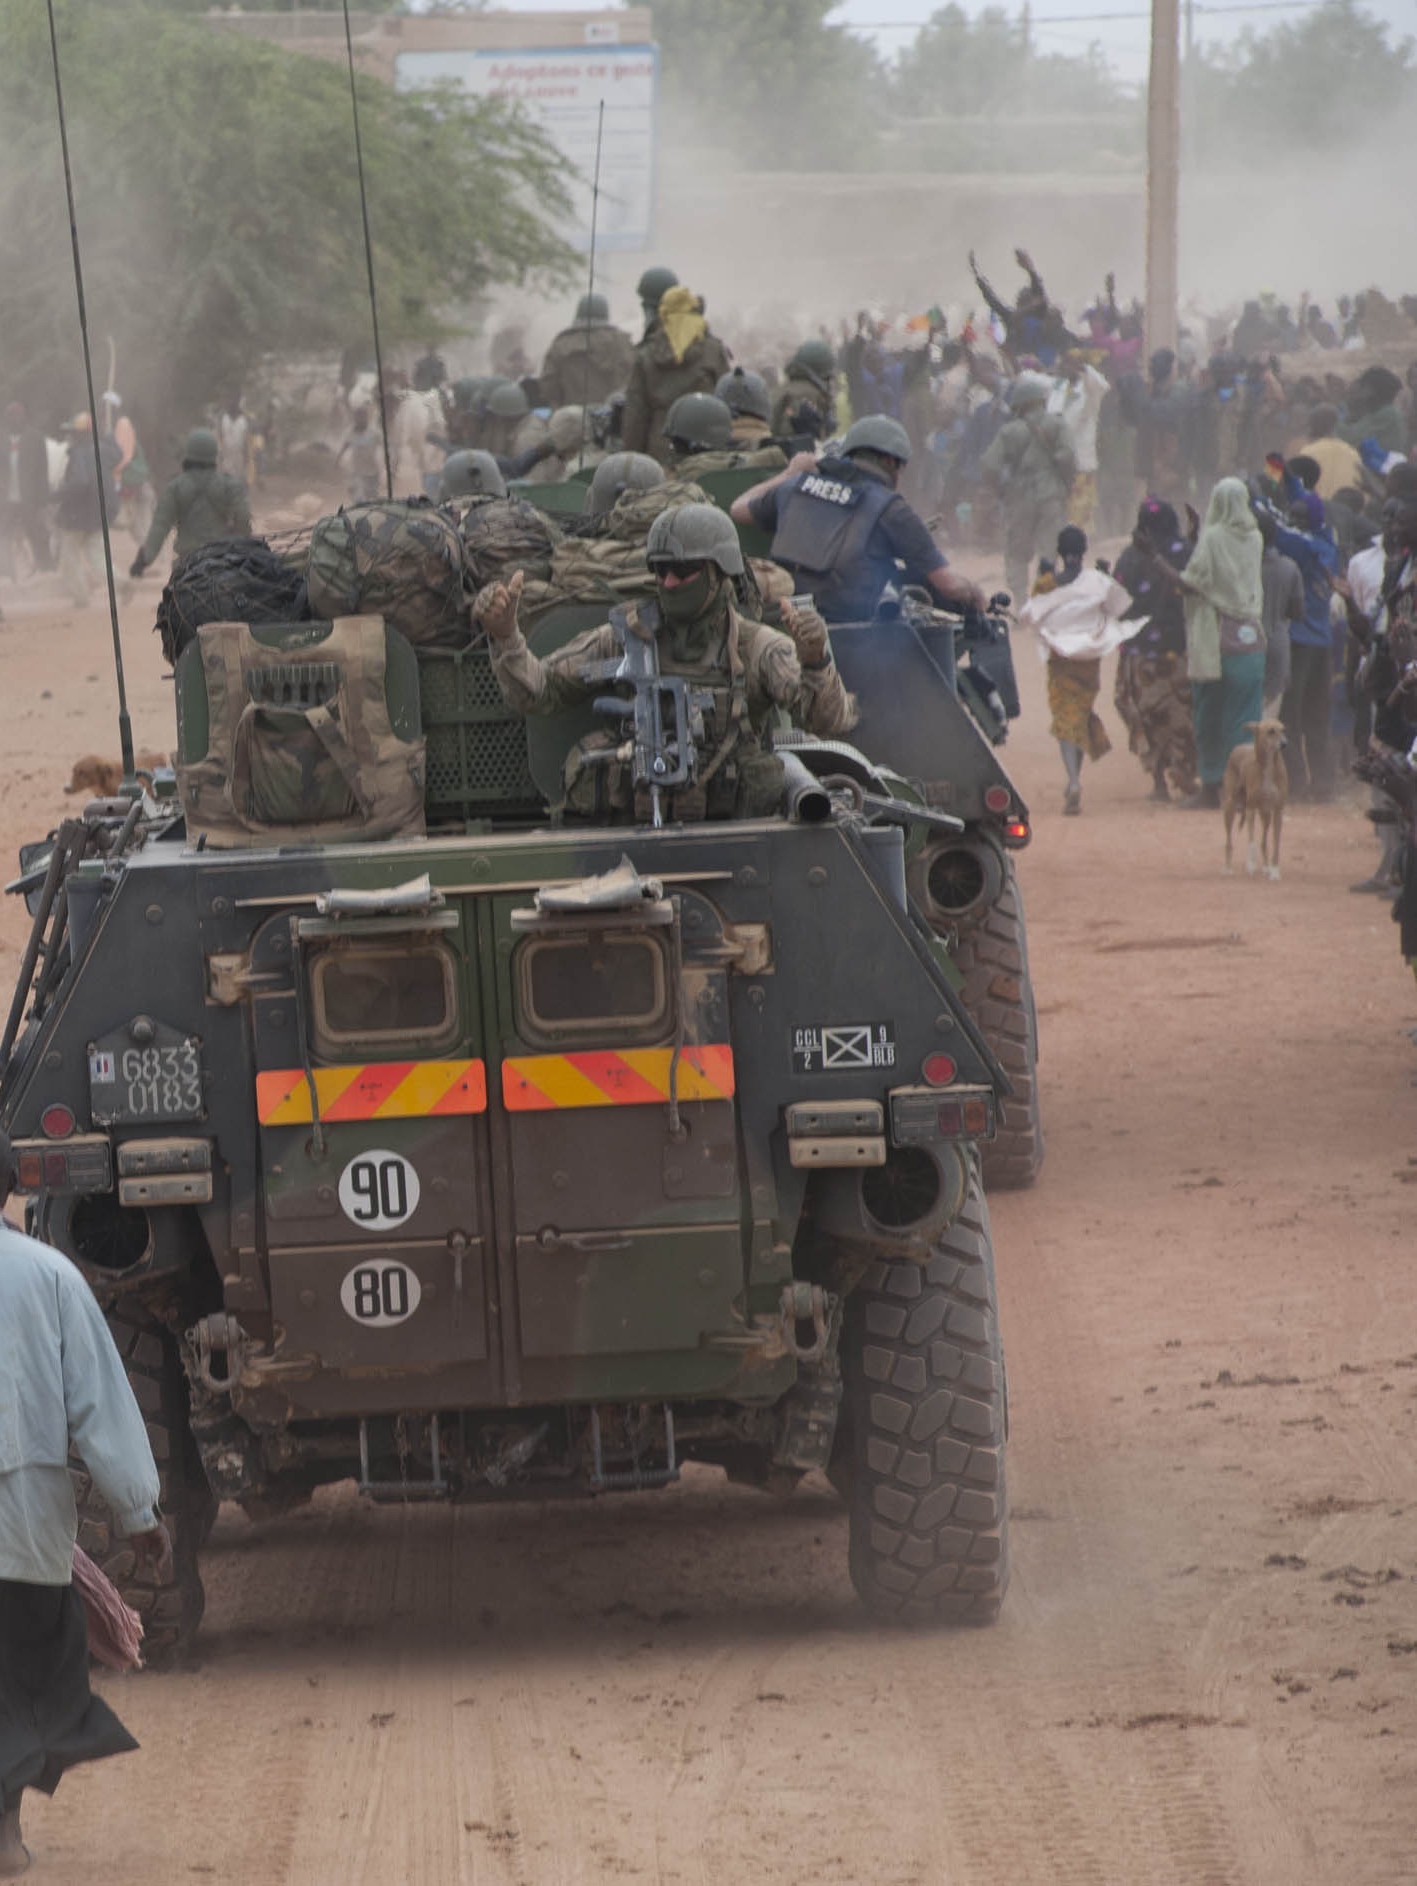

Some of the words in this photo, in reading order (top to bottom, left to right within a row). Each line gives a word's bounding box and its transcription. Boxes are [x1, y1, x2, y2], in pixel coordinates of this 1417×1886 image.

[802, 476, 852, 504] PRESS
[796, 1028, 821, 1047] CCL
[879, 1024, 887, 1043] 9
[122, 1047, 199, 1082] 6833
[803, 1051, 812, 1070] 2
[128, 1079, 202, 1114] 0183
[350, 1160, 408, 1220] 90
[353, 1267, 409, 1318] 80
